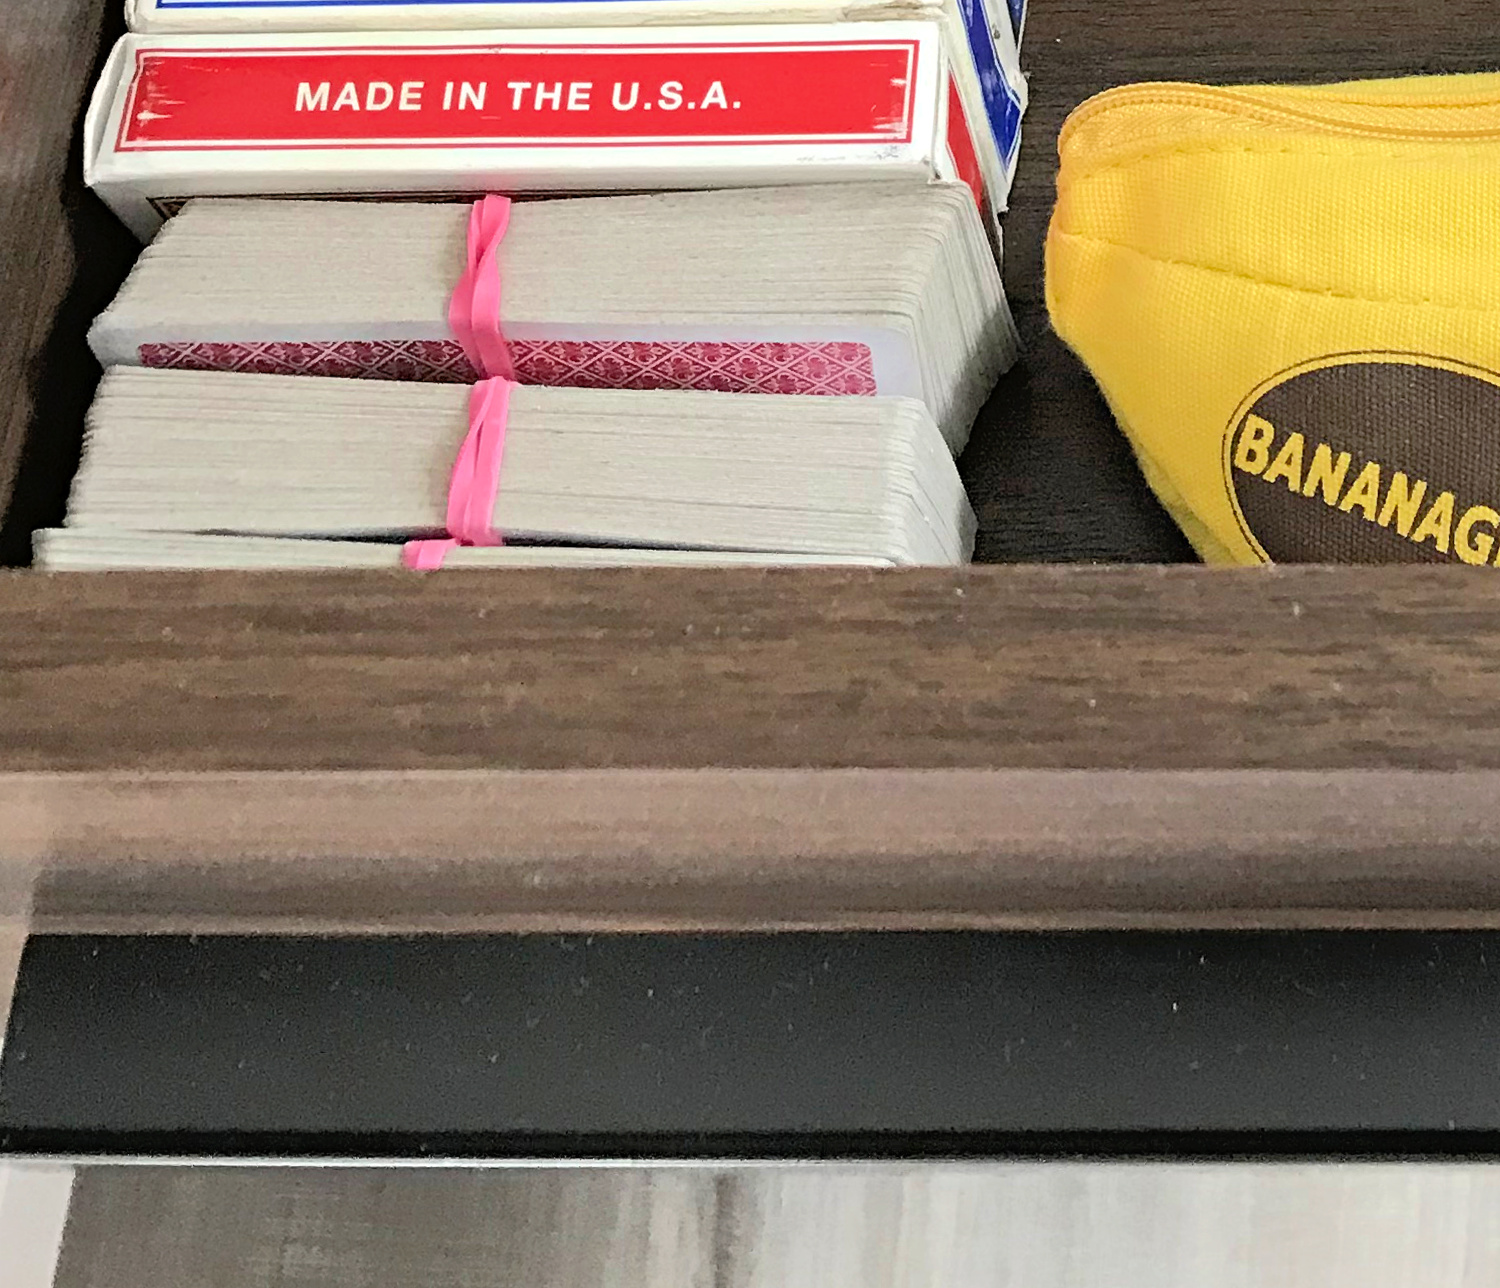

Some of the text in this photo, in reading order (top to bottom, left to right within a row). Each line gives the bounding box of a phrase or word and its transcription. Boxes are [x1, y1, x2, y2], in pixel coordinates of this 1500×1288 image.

[294, 80, 742, 112] MADE IN THE U.S.A.
